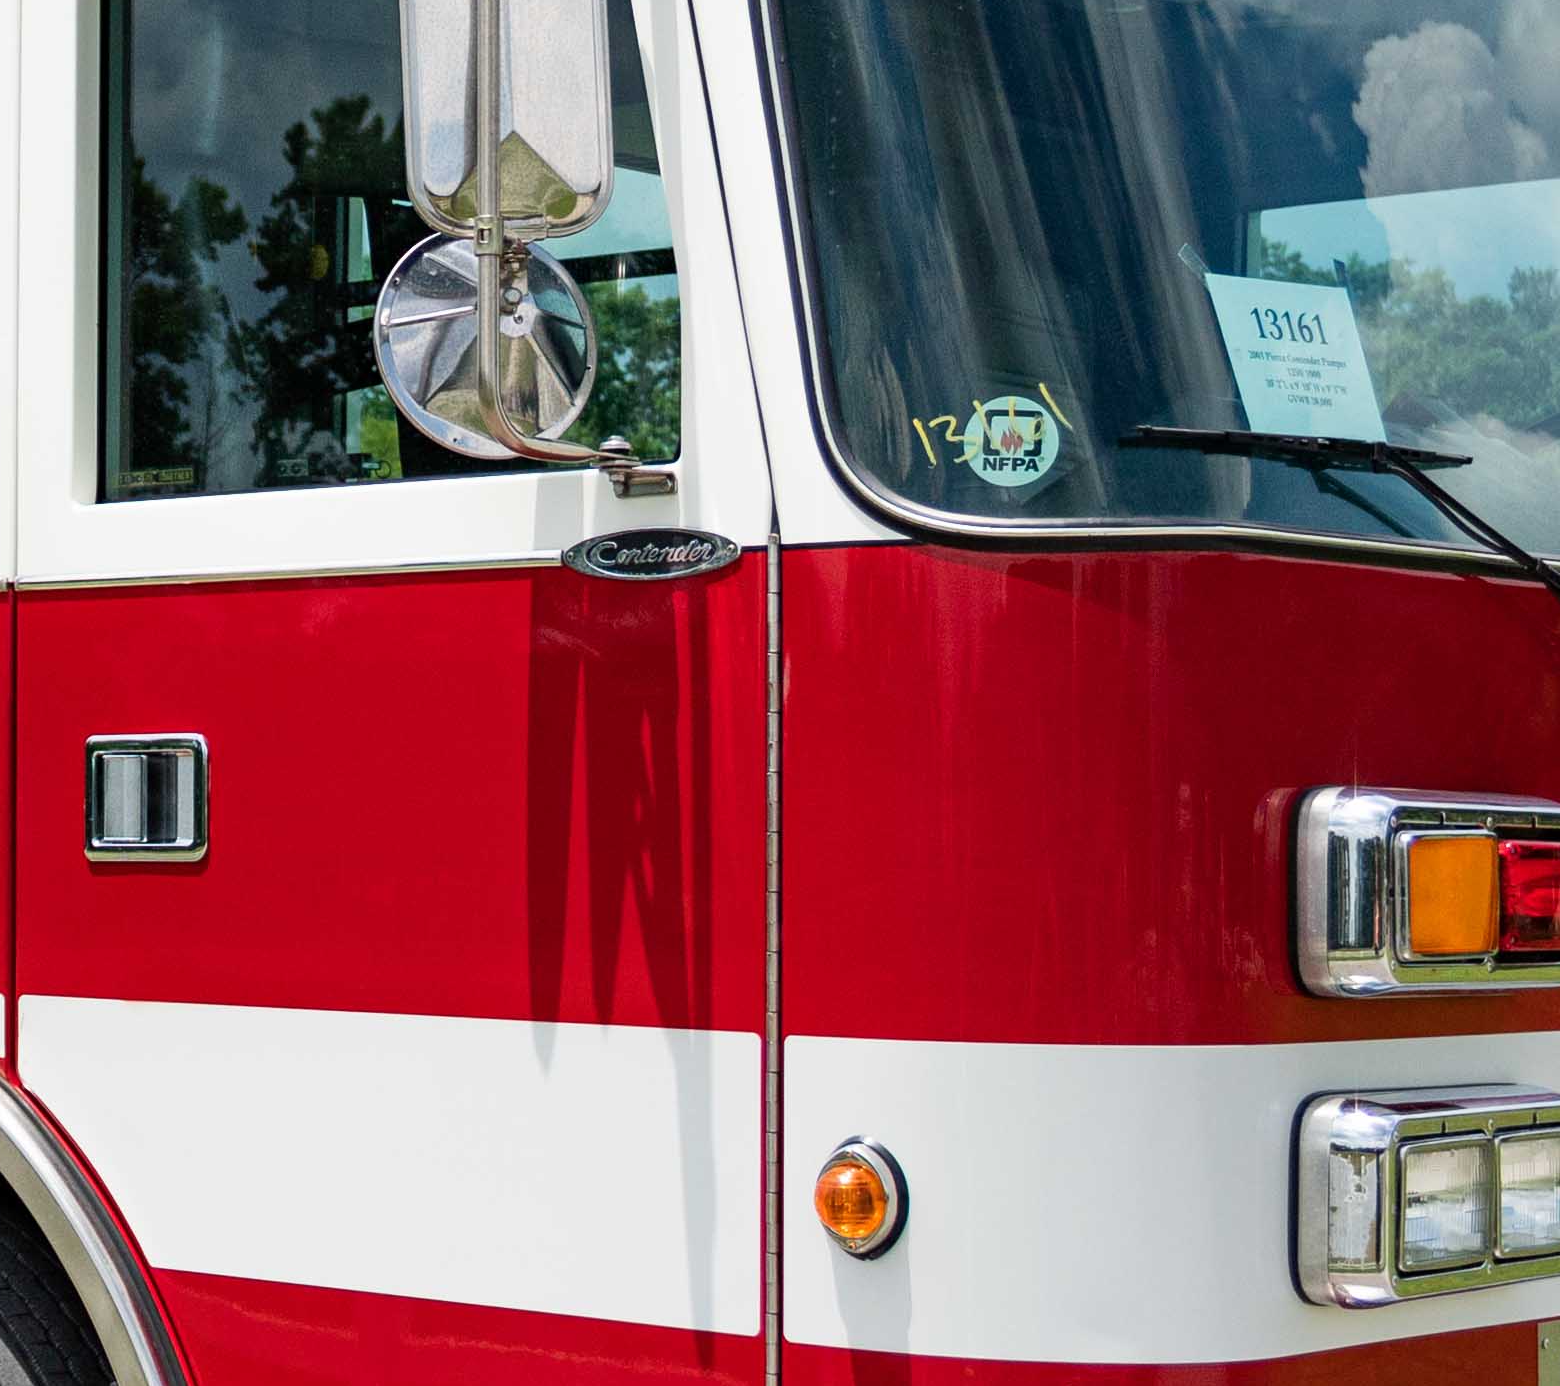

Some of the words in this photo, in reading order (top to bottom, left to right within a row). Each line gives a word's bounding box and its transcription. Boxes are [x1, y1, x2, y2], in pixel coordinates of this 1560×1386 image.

[1250, 307, 1329, 345] 13161
[982, 457, 1040, 472] NFPA
[596, 538, 713, 564] Contender
